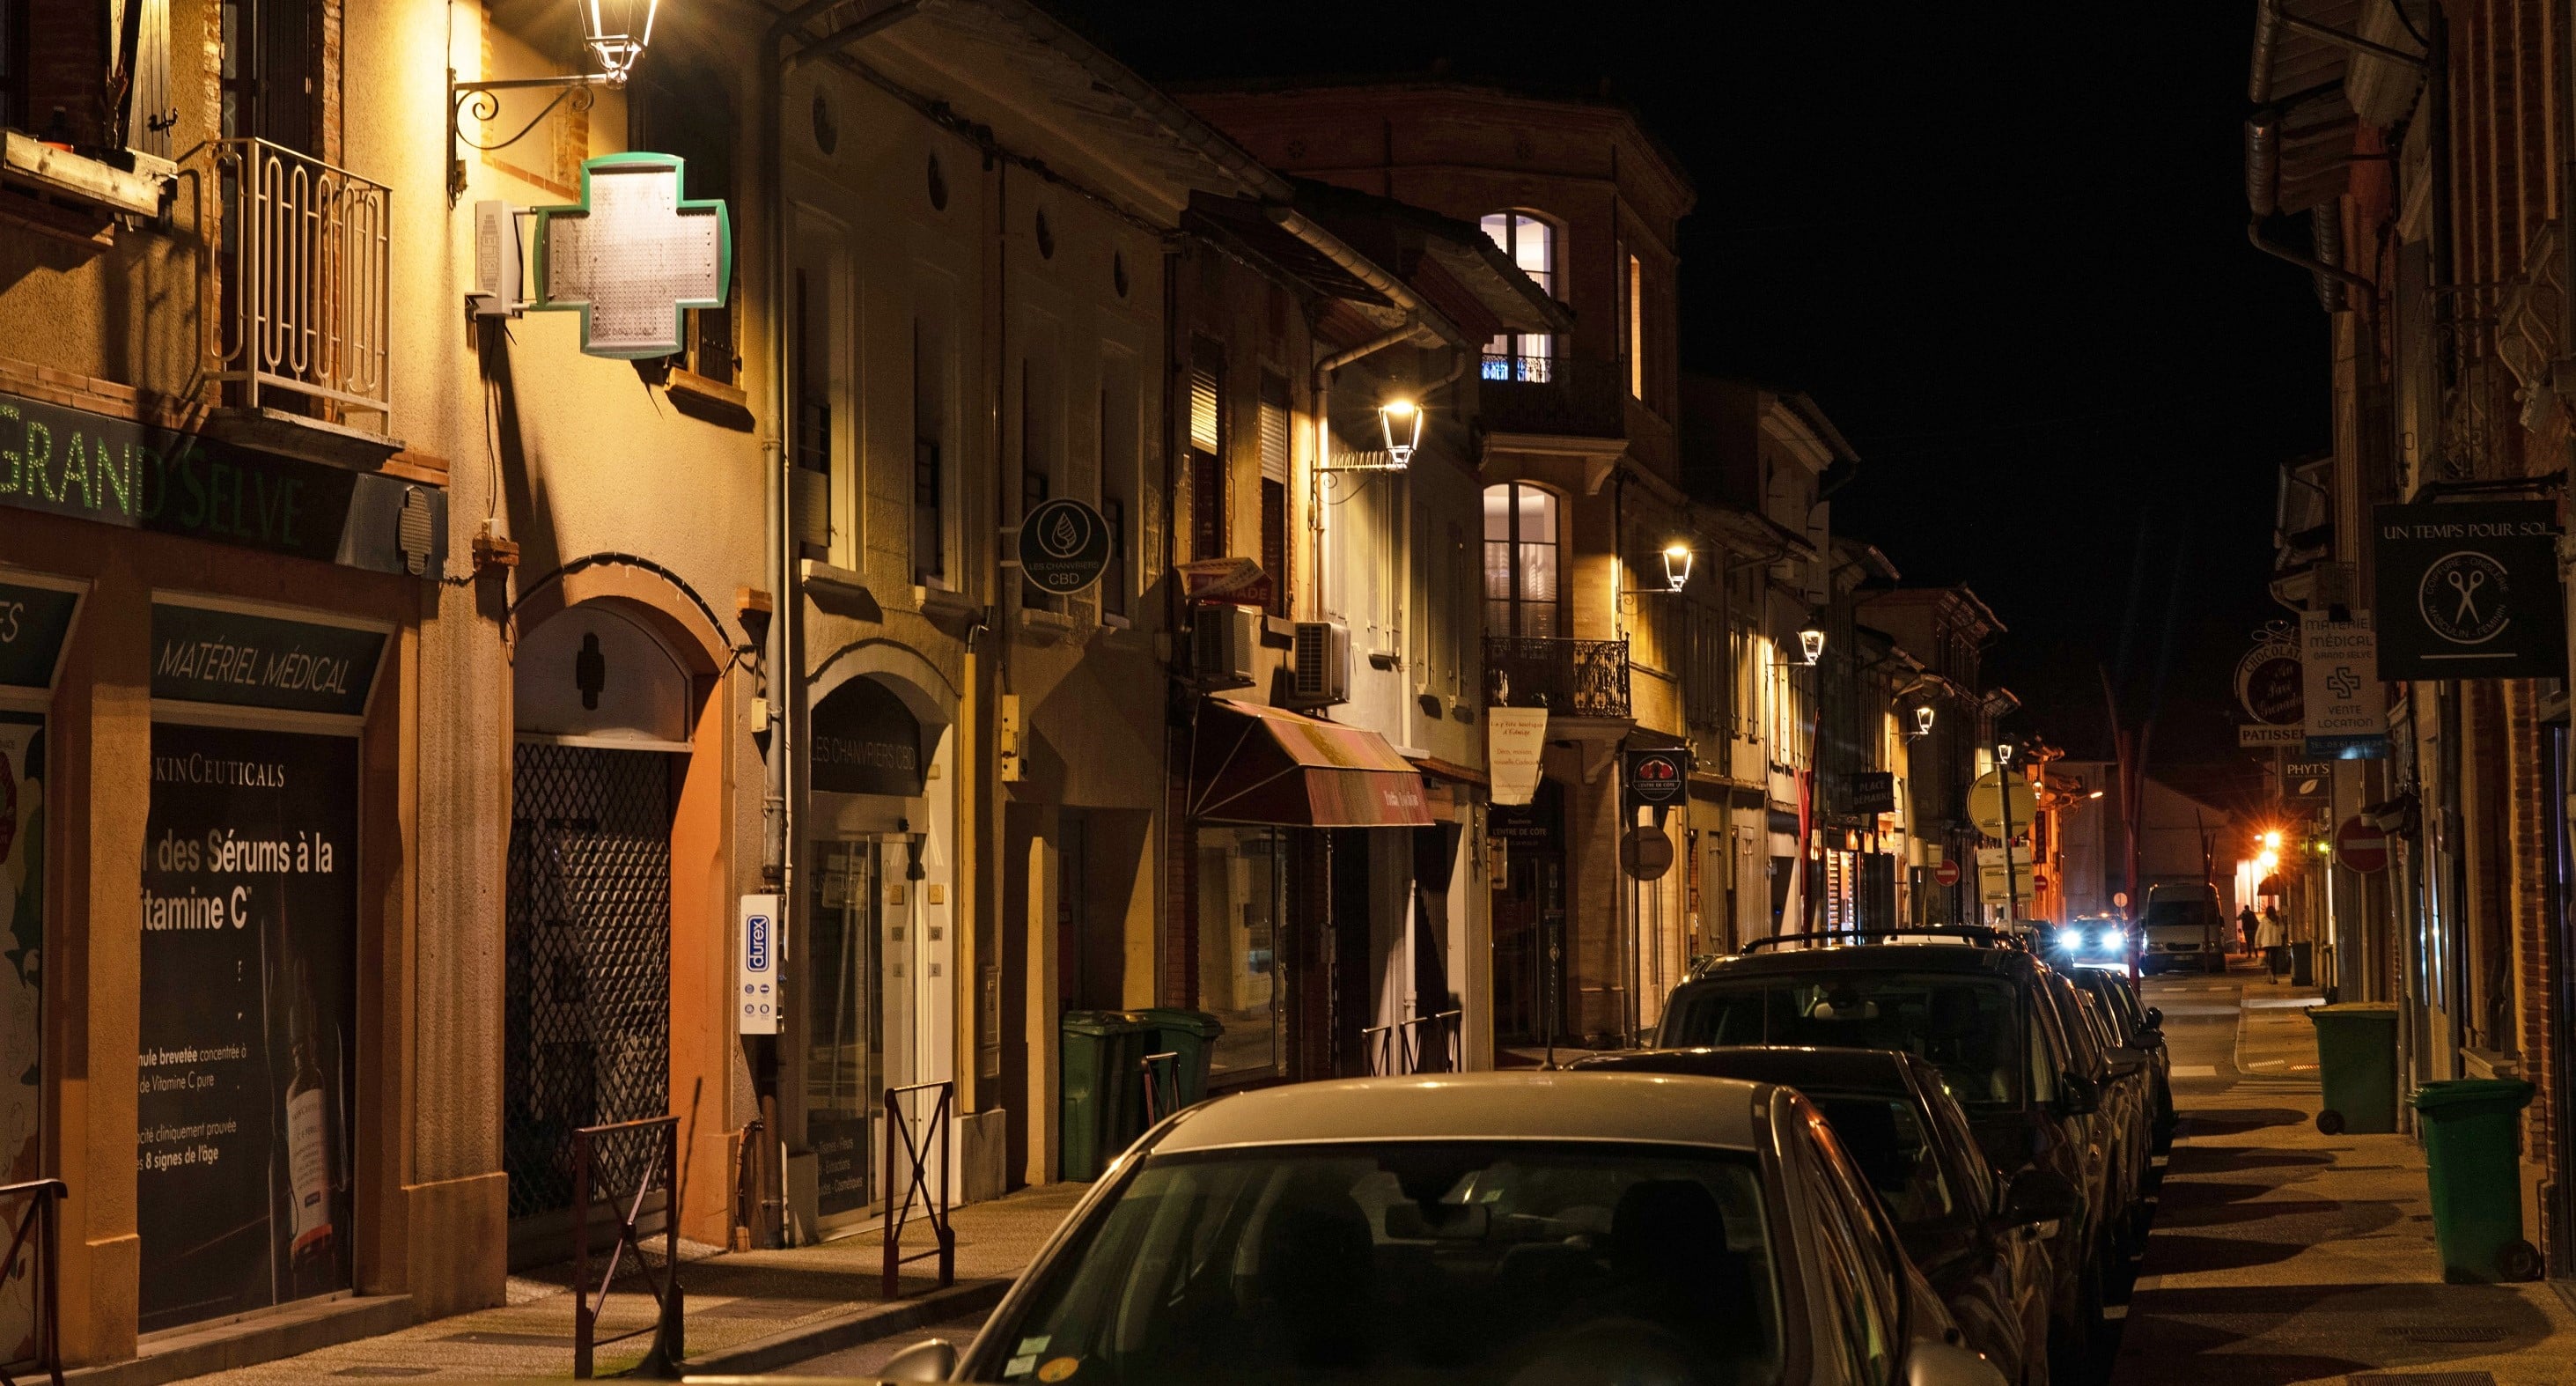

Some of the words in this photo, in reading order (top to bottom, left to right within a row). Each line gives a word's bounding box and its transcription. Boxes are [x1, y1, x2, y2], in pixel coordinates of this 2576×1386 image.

[0, 402, 166, 520] GRAND
[181, 445, 305, 548] SELVE
[2384, 526, 2409, 540] UN
[2412, 524, 2465, 539] TEMPS
[2469, 522, 2515, 537] POUR
[1049, 572, 1080, 586] CBD
[158, 634, 260, 686] MATÉRIEL
[261, 645, 349, 696] MÉDICAL
[2327, 704, 2362, 715] VENTE
[2318, 718, 2374, 729] LOCATION
[151, 753, 284, 787] KINCEUTICALS
[158, 828, 201, 873] des
[207, 828, 291, 874] Sérums
[296, 830, 309, 874] à
[314, 831, 334, 874] la
[141, 884, 224, 931] itamine
[749, 918, 766, 968] durex
[159, 1045, 198, 1065] brevetée
[199, 1043, 239, 1062] concentrée
[241, 1043, 247, 1059] à
[139, 1073, 150, 1094] de
[152, 1074, 186, 1092] Vitamine
[188, 1070, 195, 1089] C
[197, 1073, 215, 1092] pure
[156, 1122, 205, 1144] cliniquement
[206, 1117, 237, 1139] prouvée
[145, 1151, 152, 1170] 8
[154, 1150, 182, 1172] signes
[184, 1146, 195, 1164] de
[198, 1144, 219, 1165] l'âge
